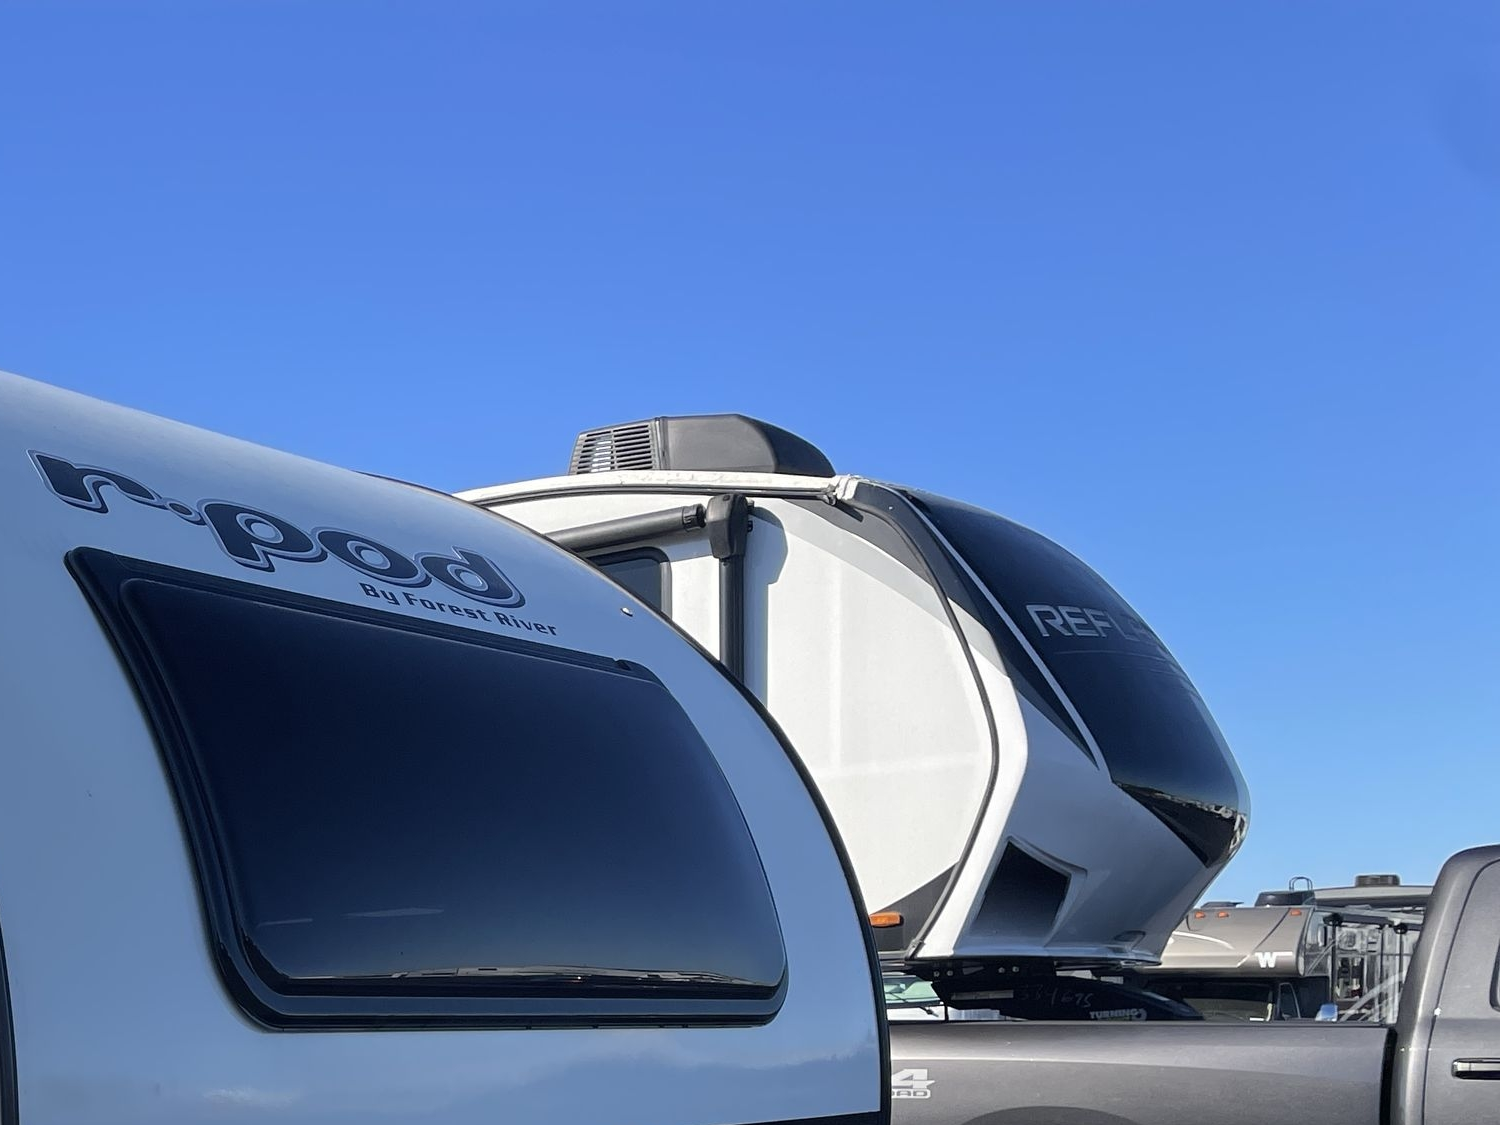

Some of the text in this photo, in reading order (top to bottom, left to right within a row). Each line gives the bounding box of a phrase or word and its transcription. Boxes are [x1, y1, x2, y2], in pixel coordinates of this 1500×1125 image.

[359, 582, 558, 636] By Forest River
